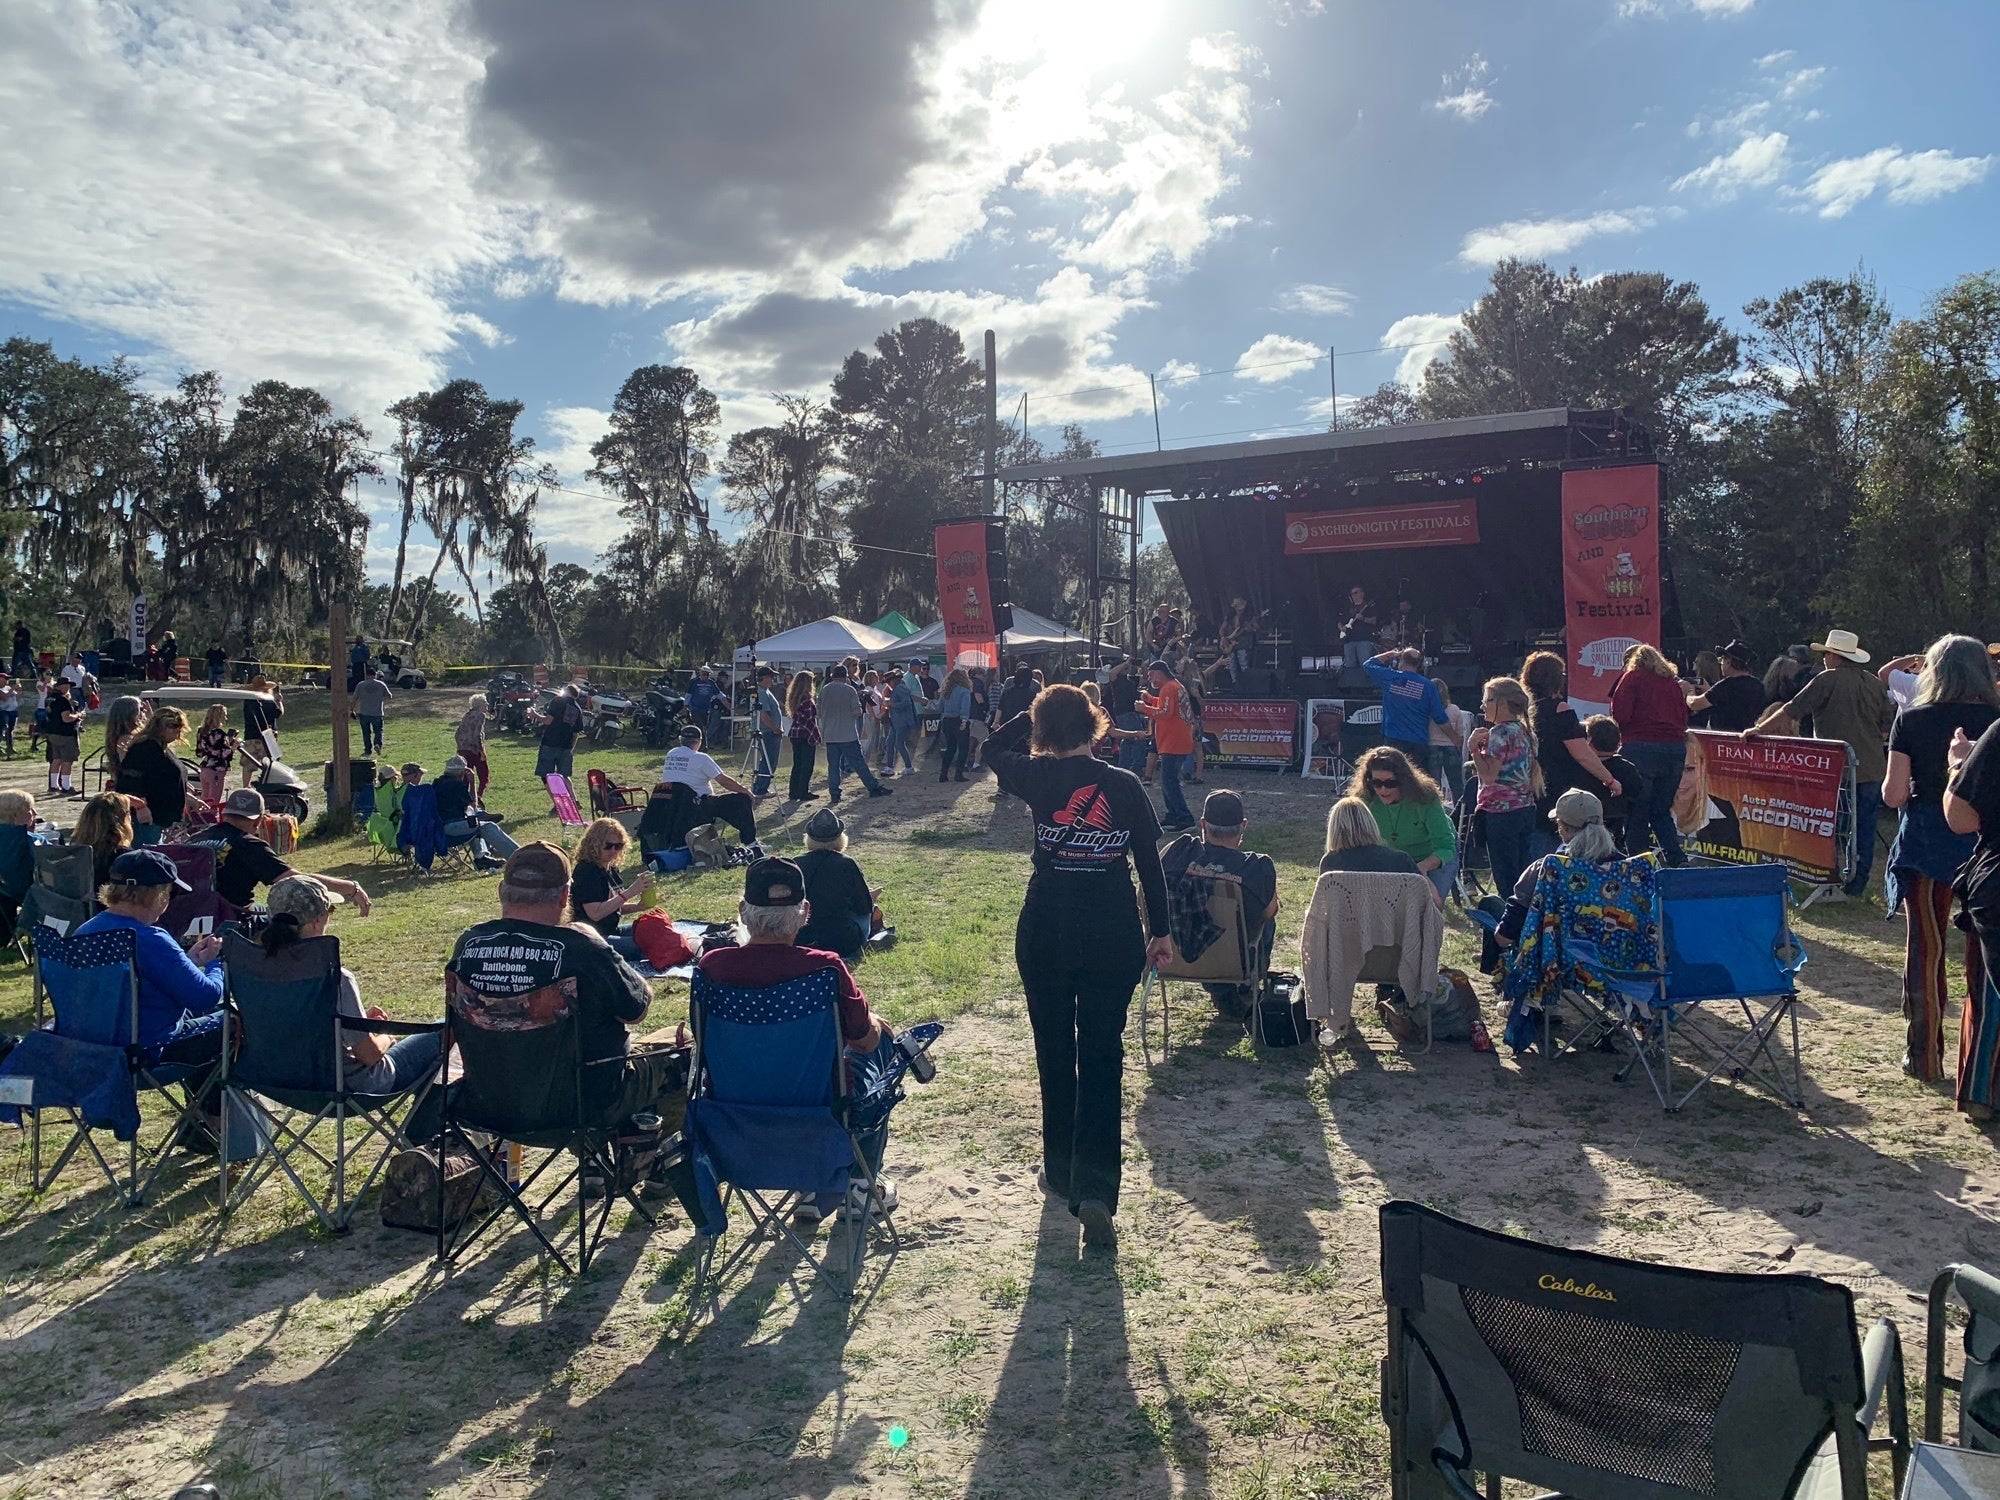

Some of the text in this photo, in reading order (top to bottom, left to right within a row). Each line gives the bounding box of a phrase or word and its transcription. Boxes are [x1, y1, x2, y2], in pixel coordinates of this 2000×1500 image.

[1400, 515, 1471, 530] FESTIVALS
[1575, 507, 1647, 525] Southern
[1577, 546, 1605, 562] AND
[1575, 599, 1652, 617] Festival
[950, 621, 989, 636] Festival
[1204, 705, 1286, 714] FRAN HAASCH
[1220, 734, 1293, 743] ACCIDENTS
[1717, 744, 1831, 770] FRAN HAASCH
[1741, 794, 1767, 807] Auto
[493, 945, 509, 959] ROCK
[510, 946, 525, 960] AND
[525, 948, 540, 962] BBQ
[541, 949, 559, 962] 2019
[482, 962, 527, 973] Rattlebone
[510, 974, 534, 984] Stone
[1538, 1274, 1615, 1301] Cabela's
